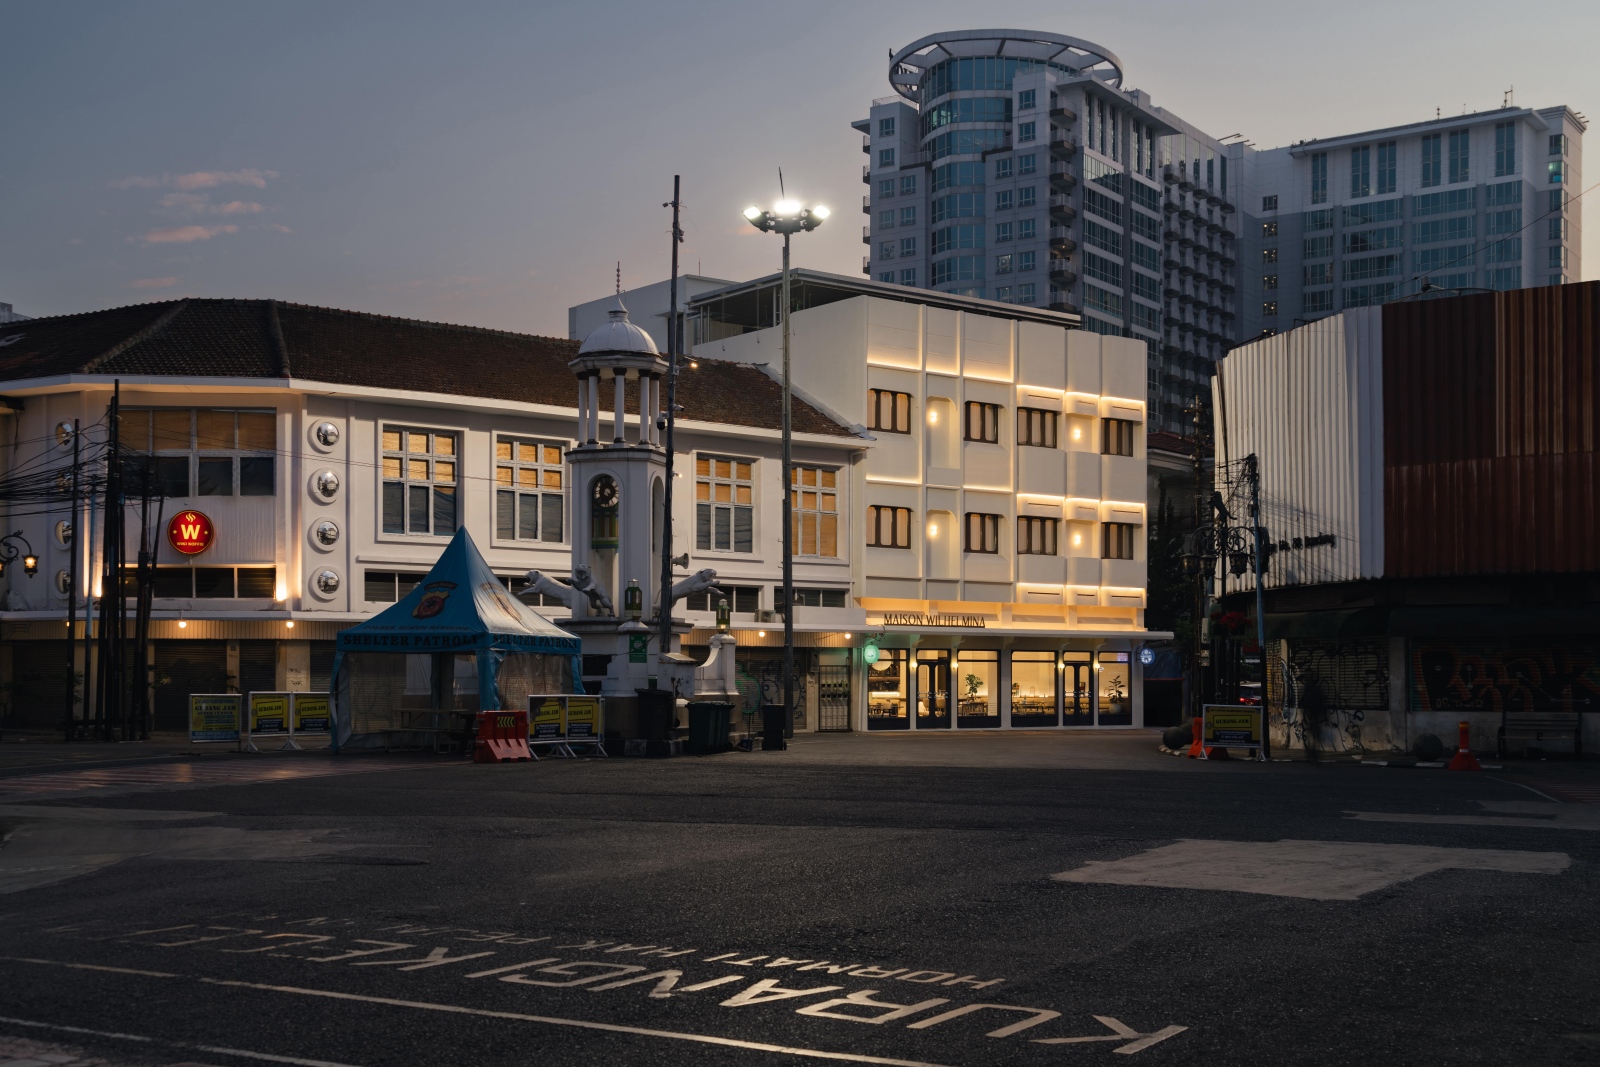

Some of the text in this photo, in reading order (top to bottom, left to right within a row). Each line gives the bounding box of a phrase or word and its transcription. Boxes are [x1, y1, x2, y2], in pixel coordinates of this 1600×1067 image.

[180, 524, 201, 540] W
[884, 613, 985, 628] MAISON WILHELMINA
[343, 633, 477, 646] SHELTER PATROLI
[493, 634, 577, 649] SHELTER PATROLI
[555, 939, 697, 958] HAK
[702, 952, 1006, 990] HORMATI
[463, 958, 1190, 1054] KURANGI
